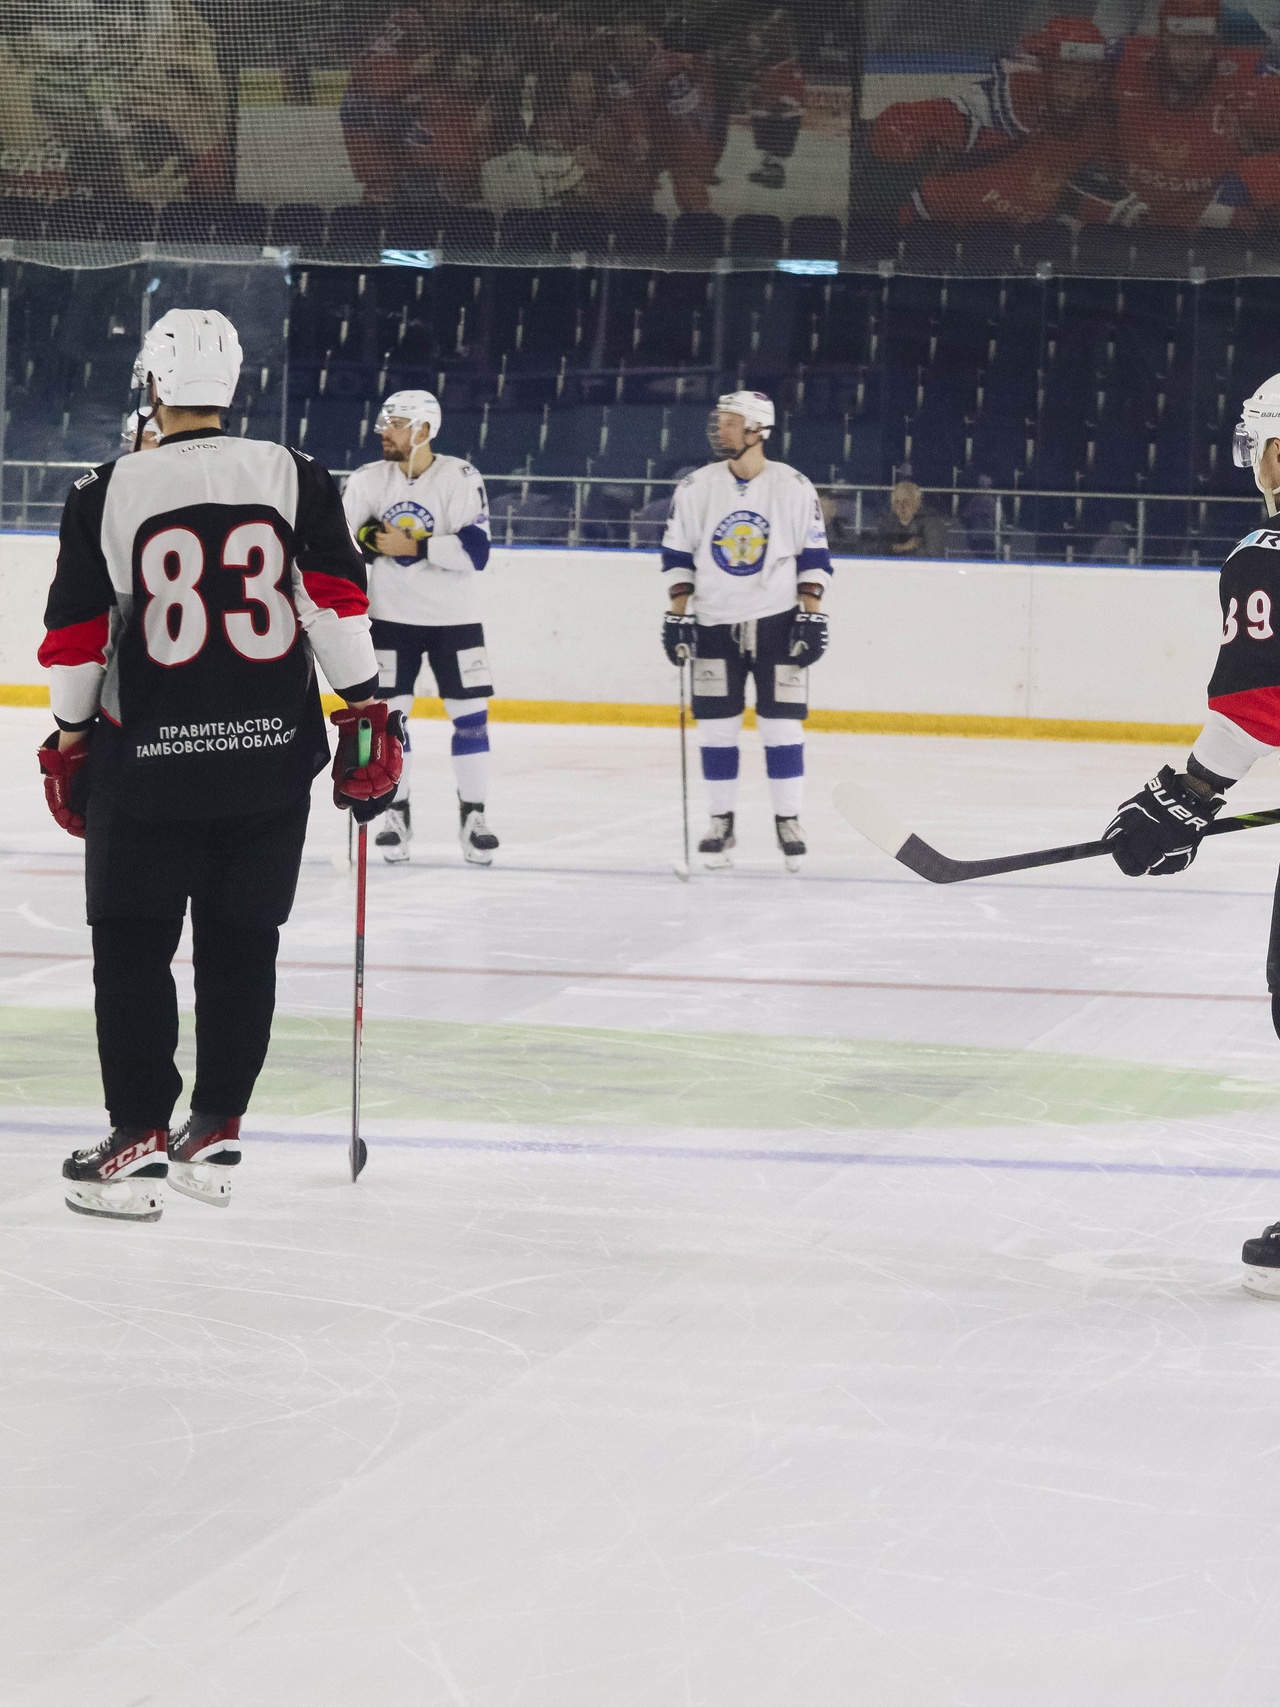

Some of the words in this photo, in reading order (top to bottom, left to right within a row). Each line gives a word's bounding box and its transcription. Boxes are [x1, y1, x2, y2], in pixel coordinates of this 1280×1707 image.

[141, 520, 299, 668] 83
[159, 717, 283, 739] ПРАВИТЕЛЬСТВО
[136, 734, 239, 758] ТАМБОВСКОЙ
[174, 1132, 190, 1150] CCM
[98, 1135, 157, 1179] CCM
